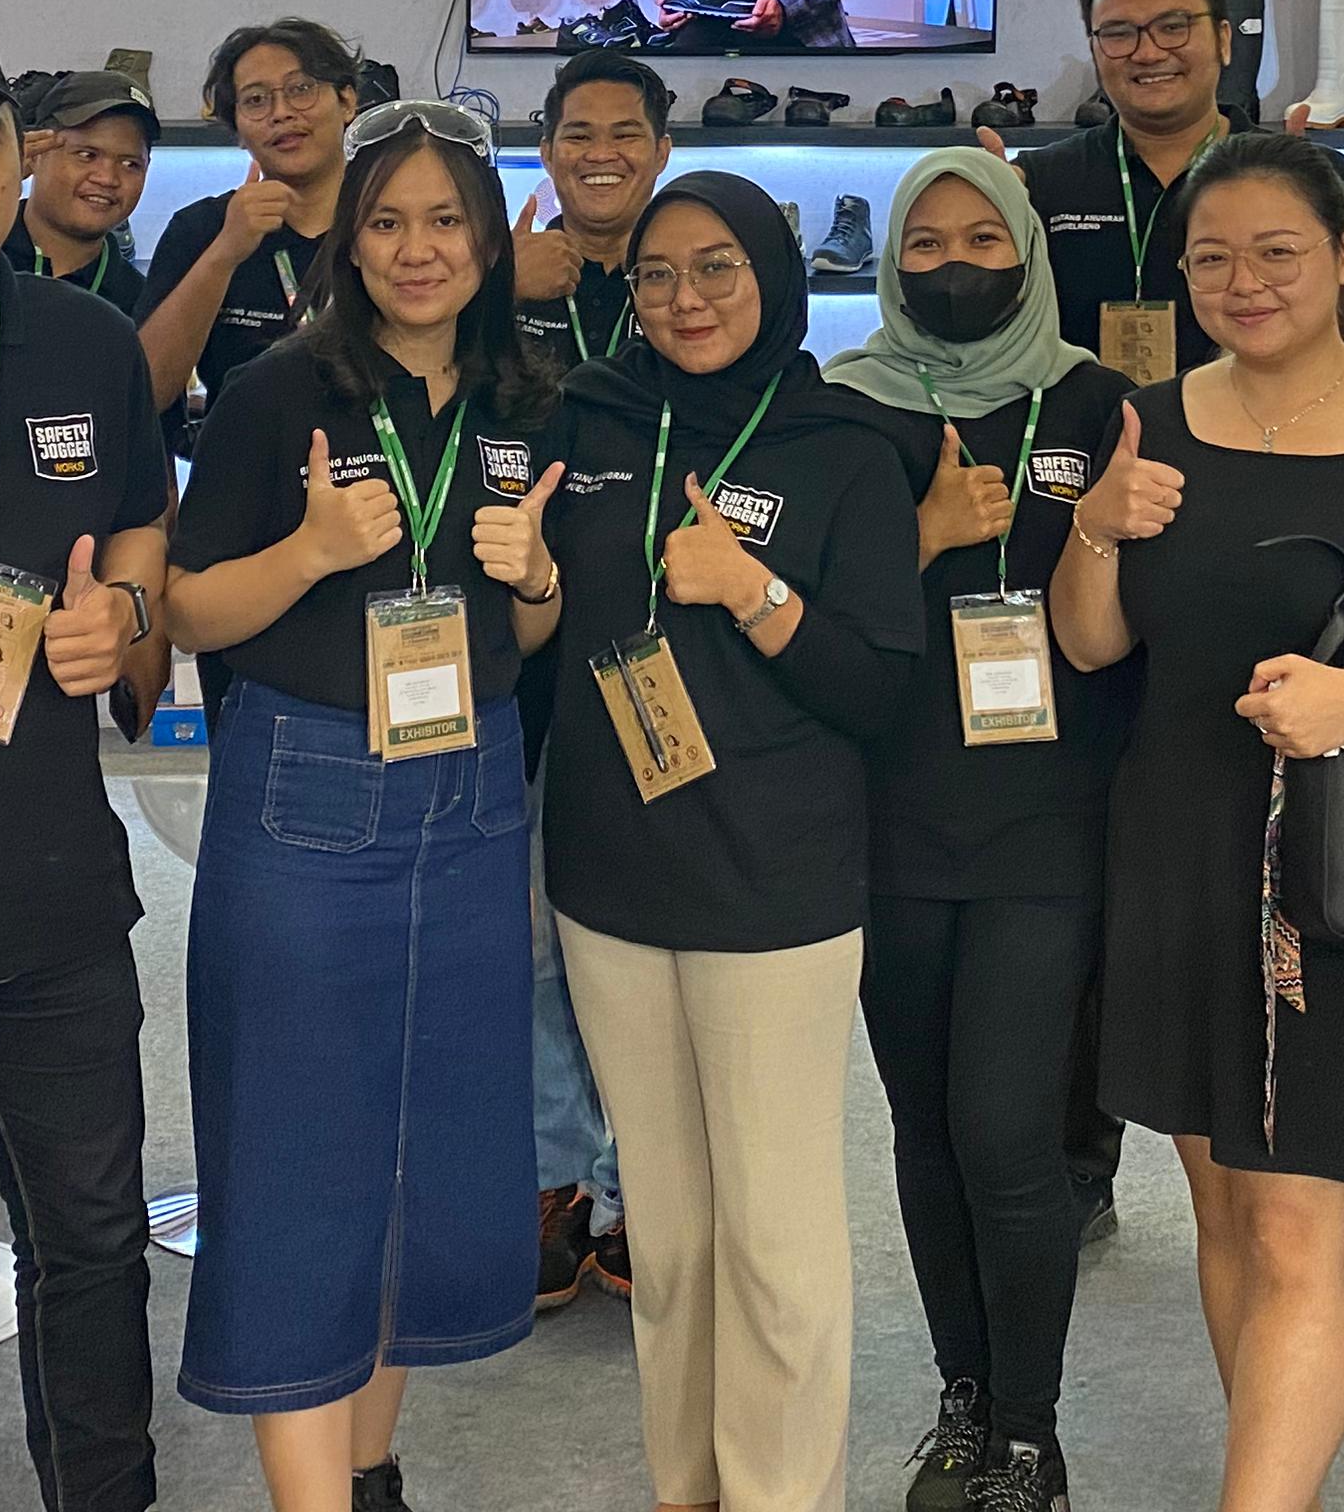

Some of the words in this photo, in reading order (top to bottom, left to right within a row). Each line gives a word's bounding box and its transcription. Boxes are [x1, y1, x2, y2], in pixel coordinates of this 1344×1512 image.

[35, 423, 88, 443] SAFETY
[37, 441, 91, 460] JOGGER
[484, 446, 528, 466] SAFETY
[53, 461, 85, 472] WORKS
[346, 454, 387, 467] ANUGRA
[1032, 456, 1085, 474] SAFETY
[718, 489, 774, 514] SAFETY
[714, 500, 769, 529] JOGGER
[981, 713, 1038, 728] EXHIBITOR
[399, 720, 457, 741] EXHIBITOR
